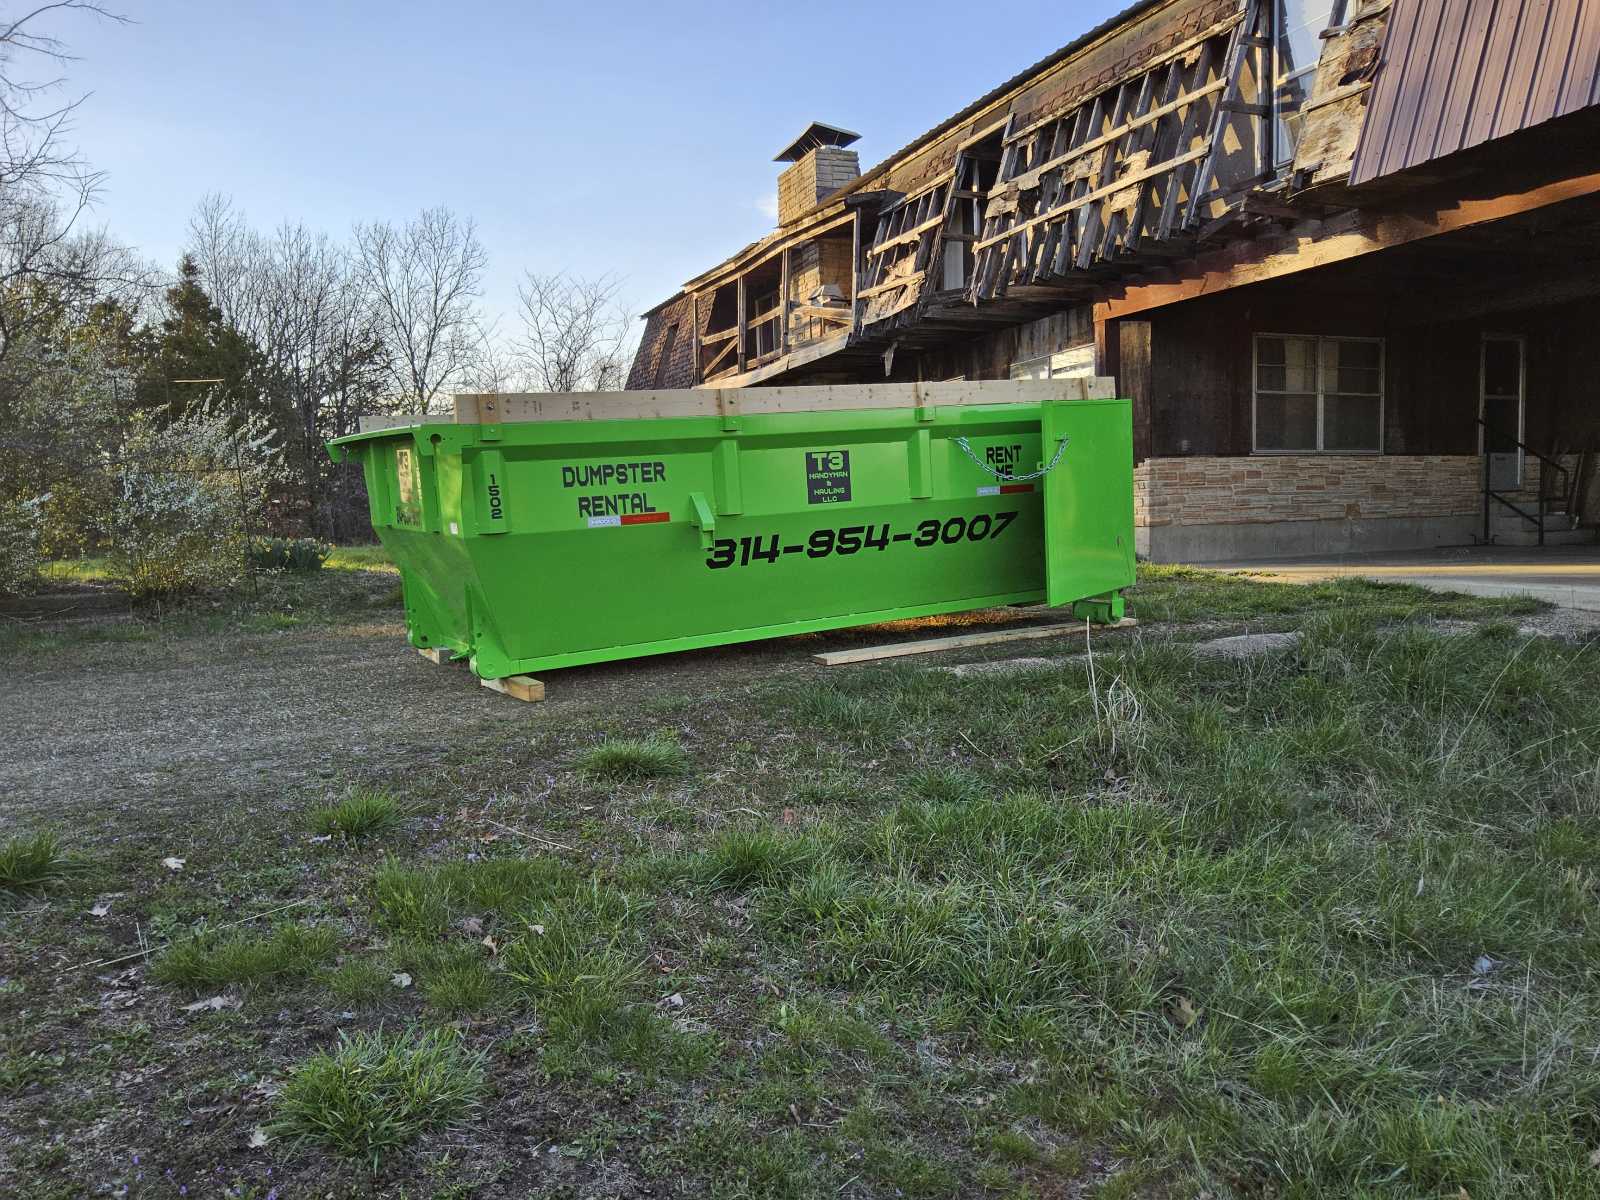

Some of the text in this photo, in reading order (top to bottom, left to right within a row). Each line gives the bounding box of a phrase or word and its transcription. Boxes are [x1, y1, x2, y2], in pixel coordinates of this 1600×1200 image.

[812, 452, 844, 471] T3
[986, 445, 1022, 464] RENT
[562, 463, 666, 488] DUMPSTER
[809, 471, 848, 479] HANDYMAN
[995, 464, 1013, 482] ME
[814, 487, 845, 495] HAULING
[578, 493, 656, 518] RENTAL
[706, 511, 1018, 570] 314-954-3007
